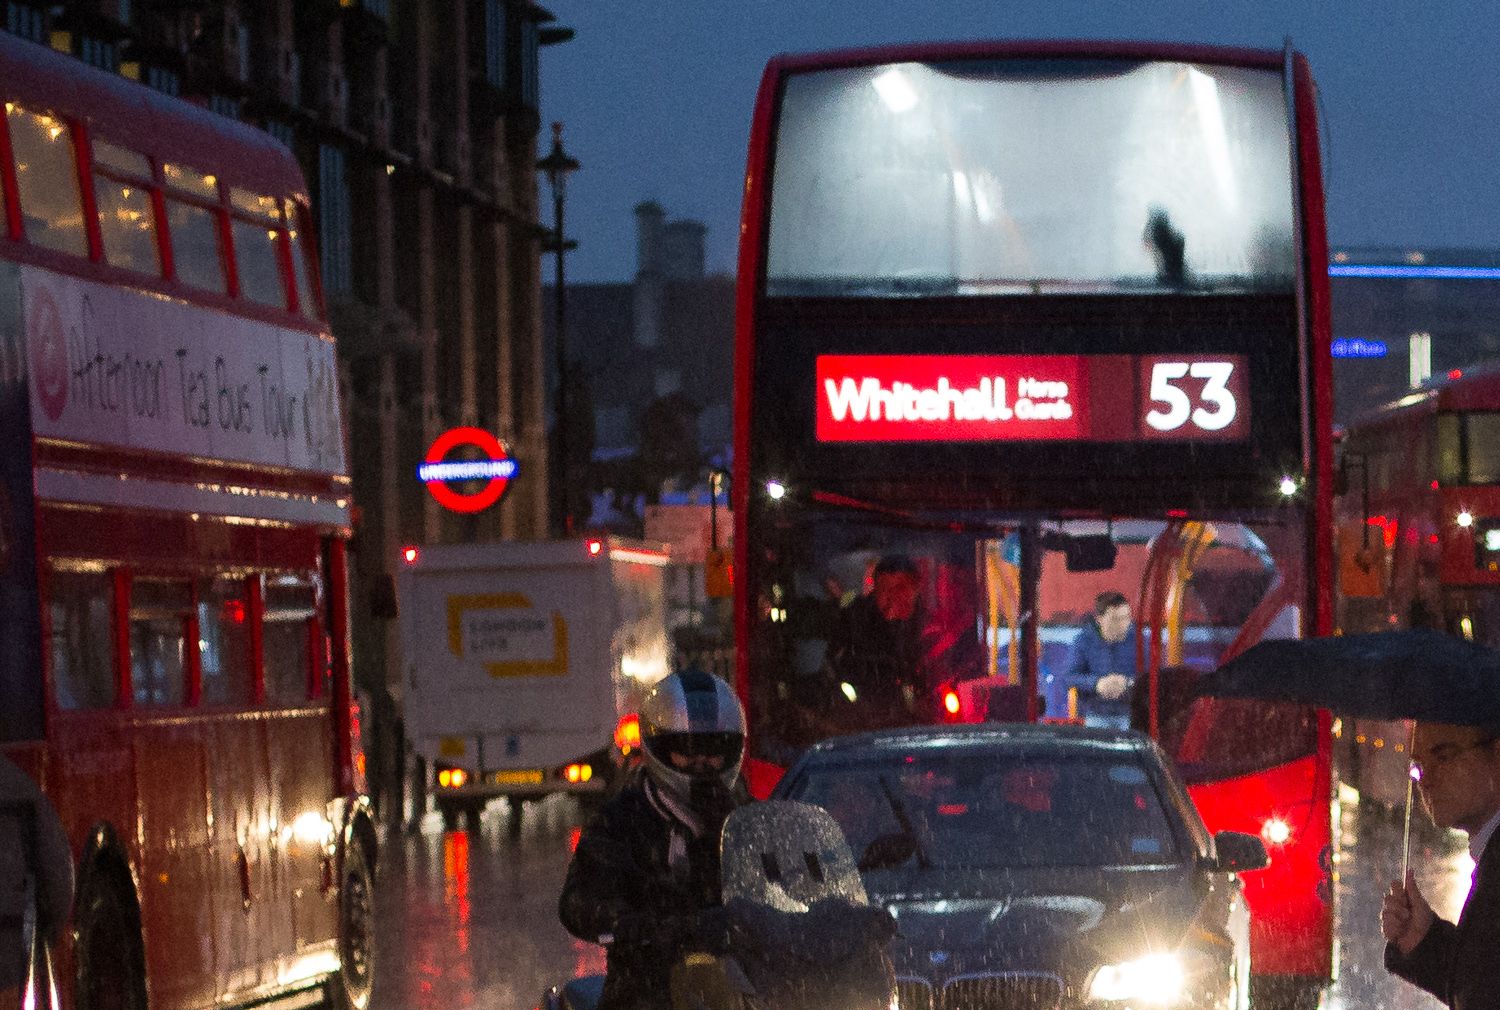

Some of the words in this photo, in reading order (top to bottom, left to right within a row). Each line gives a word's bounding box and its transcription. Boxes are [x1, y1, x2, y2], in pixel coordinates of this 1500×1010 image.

[70, 294, 169, 422] Afternoon
[175, 348, 210, 428] Tea
[258, 364, 298, 438] Tour
[824, 376, 1013, 421] Whitehall
[1145, 362, 1237, 431] 53
